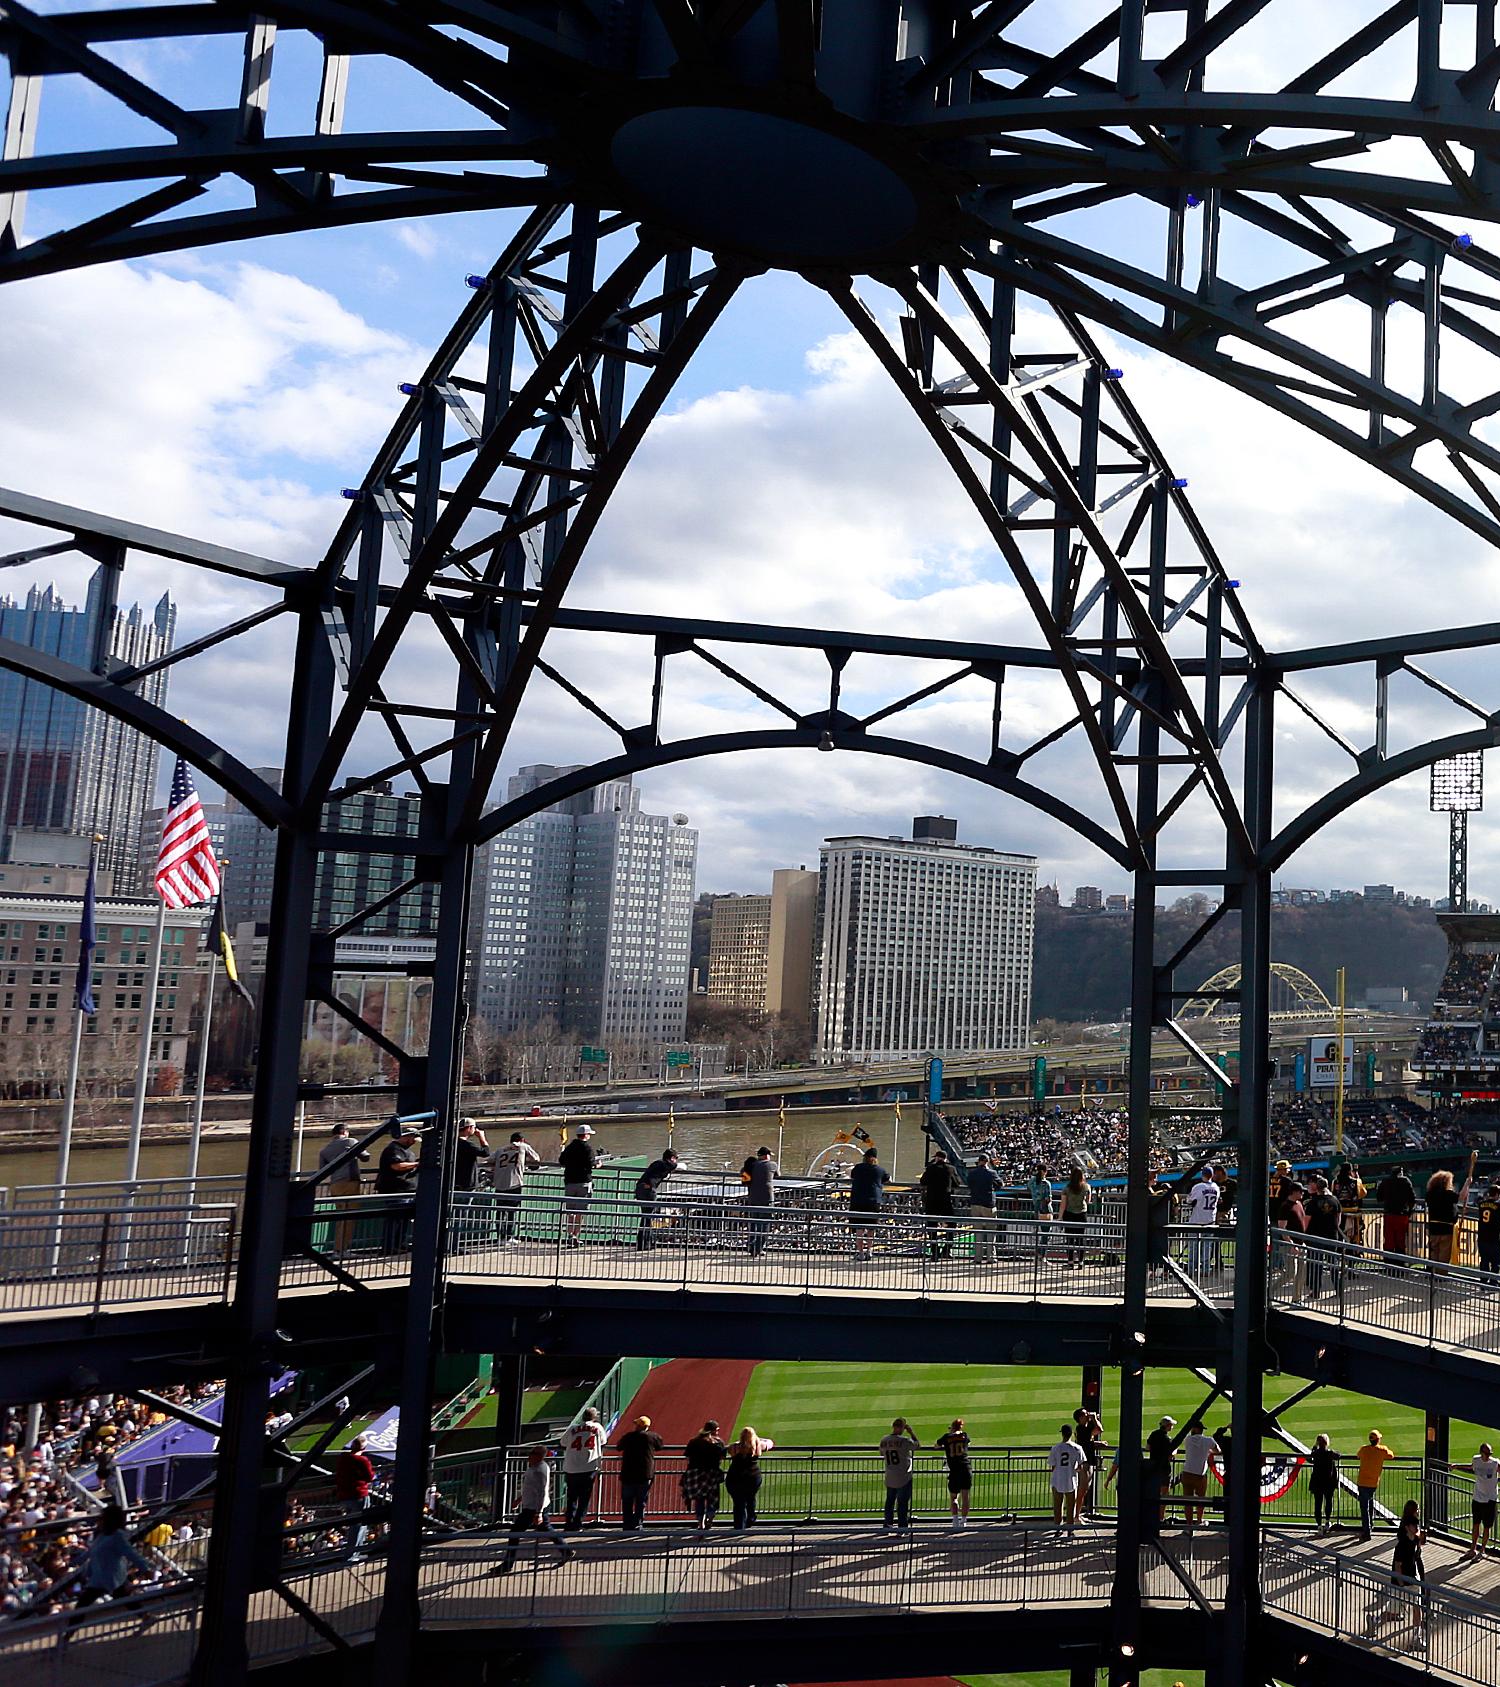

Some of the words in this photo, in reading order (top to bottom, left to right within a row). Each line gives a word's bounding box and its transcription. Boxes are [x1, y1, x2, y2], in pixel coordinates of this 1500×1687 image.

[499, 1152, 519, 1168] 24
[1269, 1184, 1281, 1198] 17
[1203, 1195, 1217, 1210] 12
[1482, 1209, 1491, 1223] 9
[571, 1435, 595, 1451] 44
[885, 1450, 900, 1466] 18
[1060, 1452, 1070, 1467] 2
